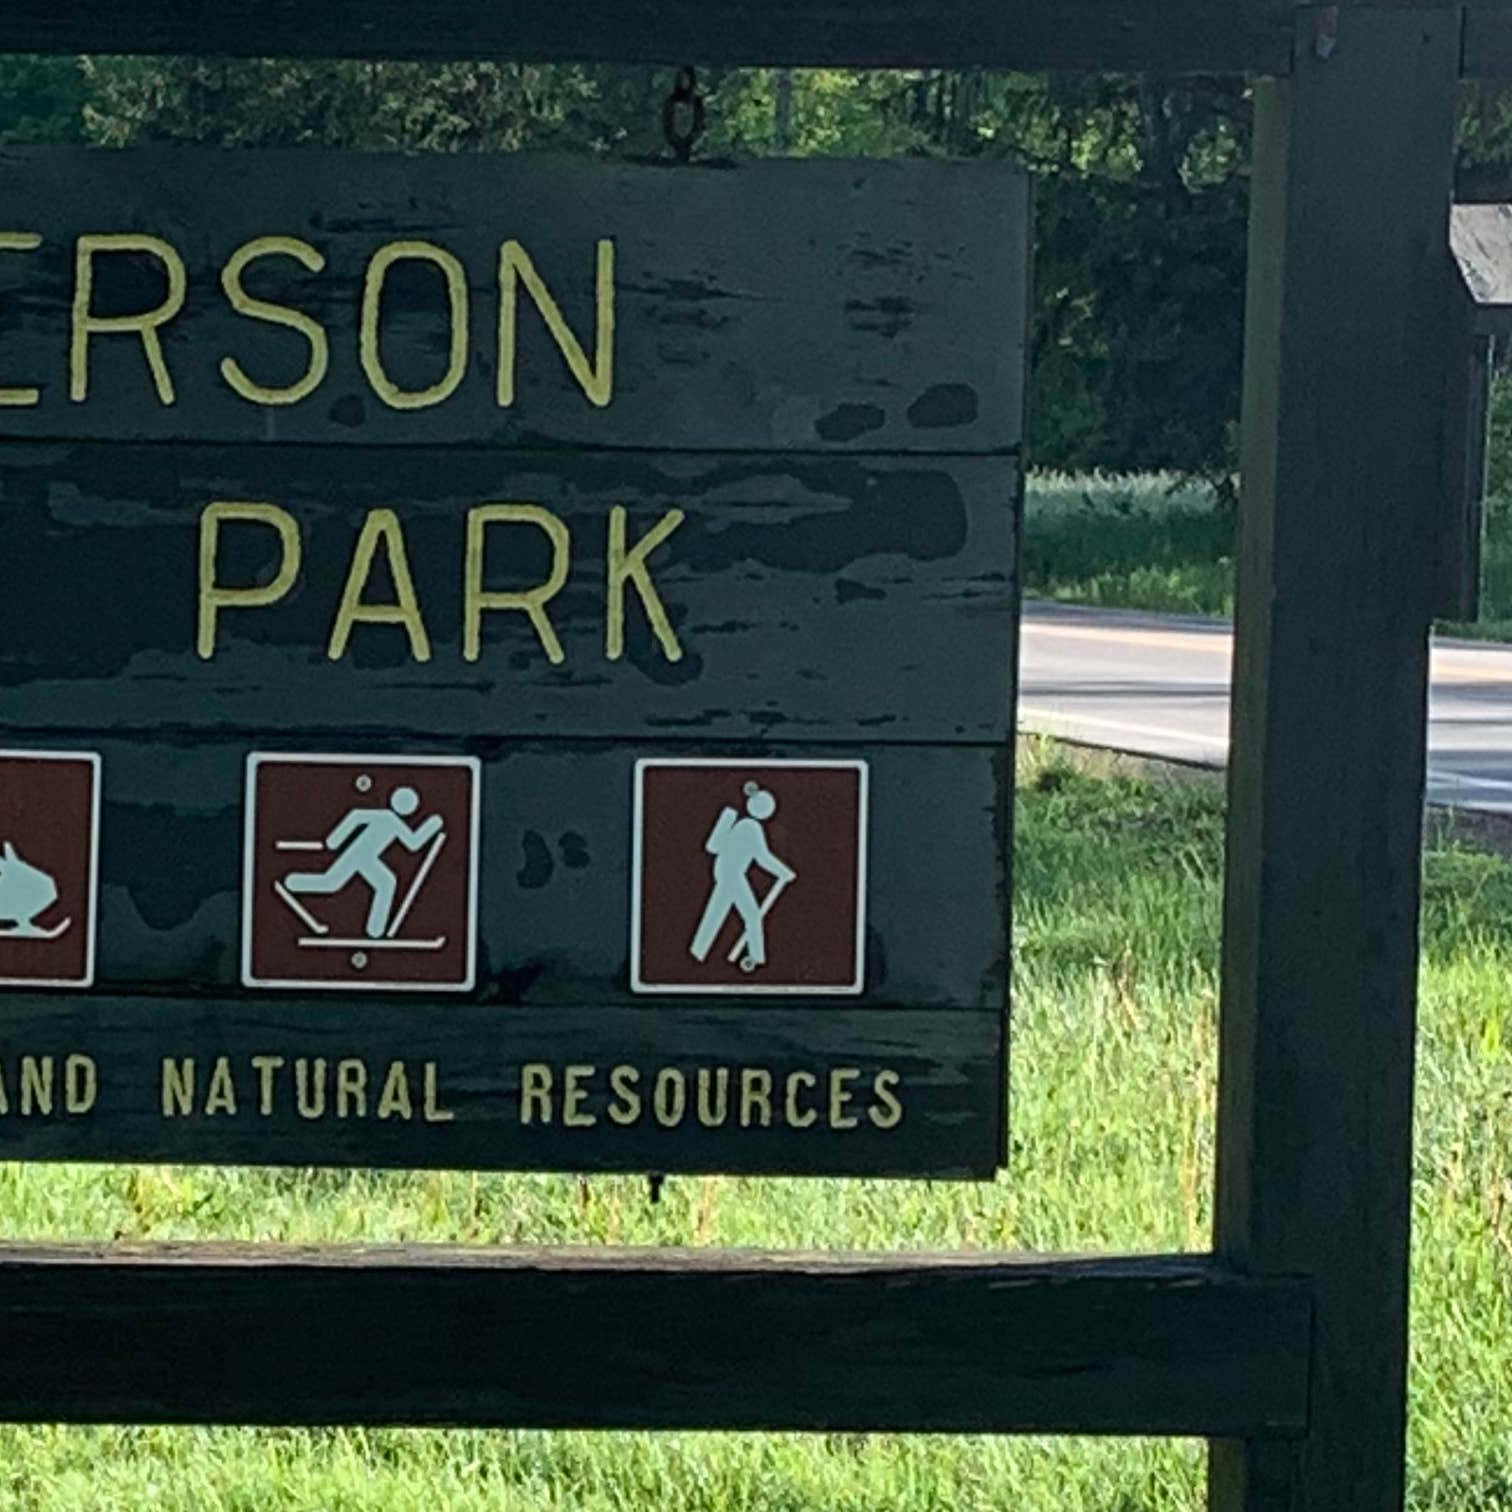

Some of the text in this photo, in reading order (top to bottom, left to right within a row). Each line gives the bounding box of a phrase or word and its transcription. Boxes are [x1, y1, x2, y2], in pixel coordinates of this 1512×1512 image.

[196, 501, 686, 665] PARK
[161, 1057, 454, 1123] NATURAL
[520, 1063, 904, 1130] RESOURCES
